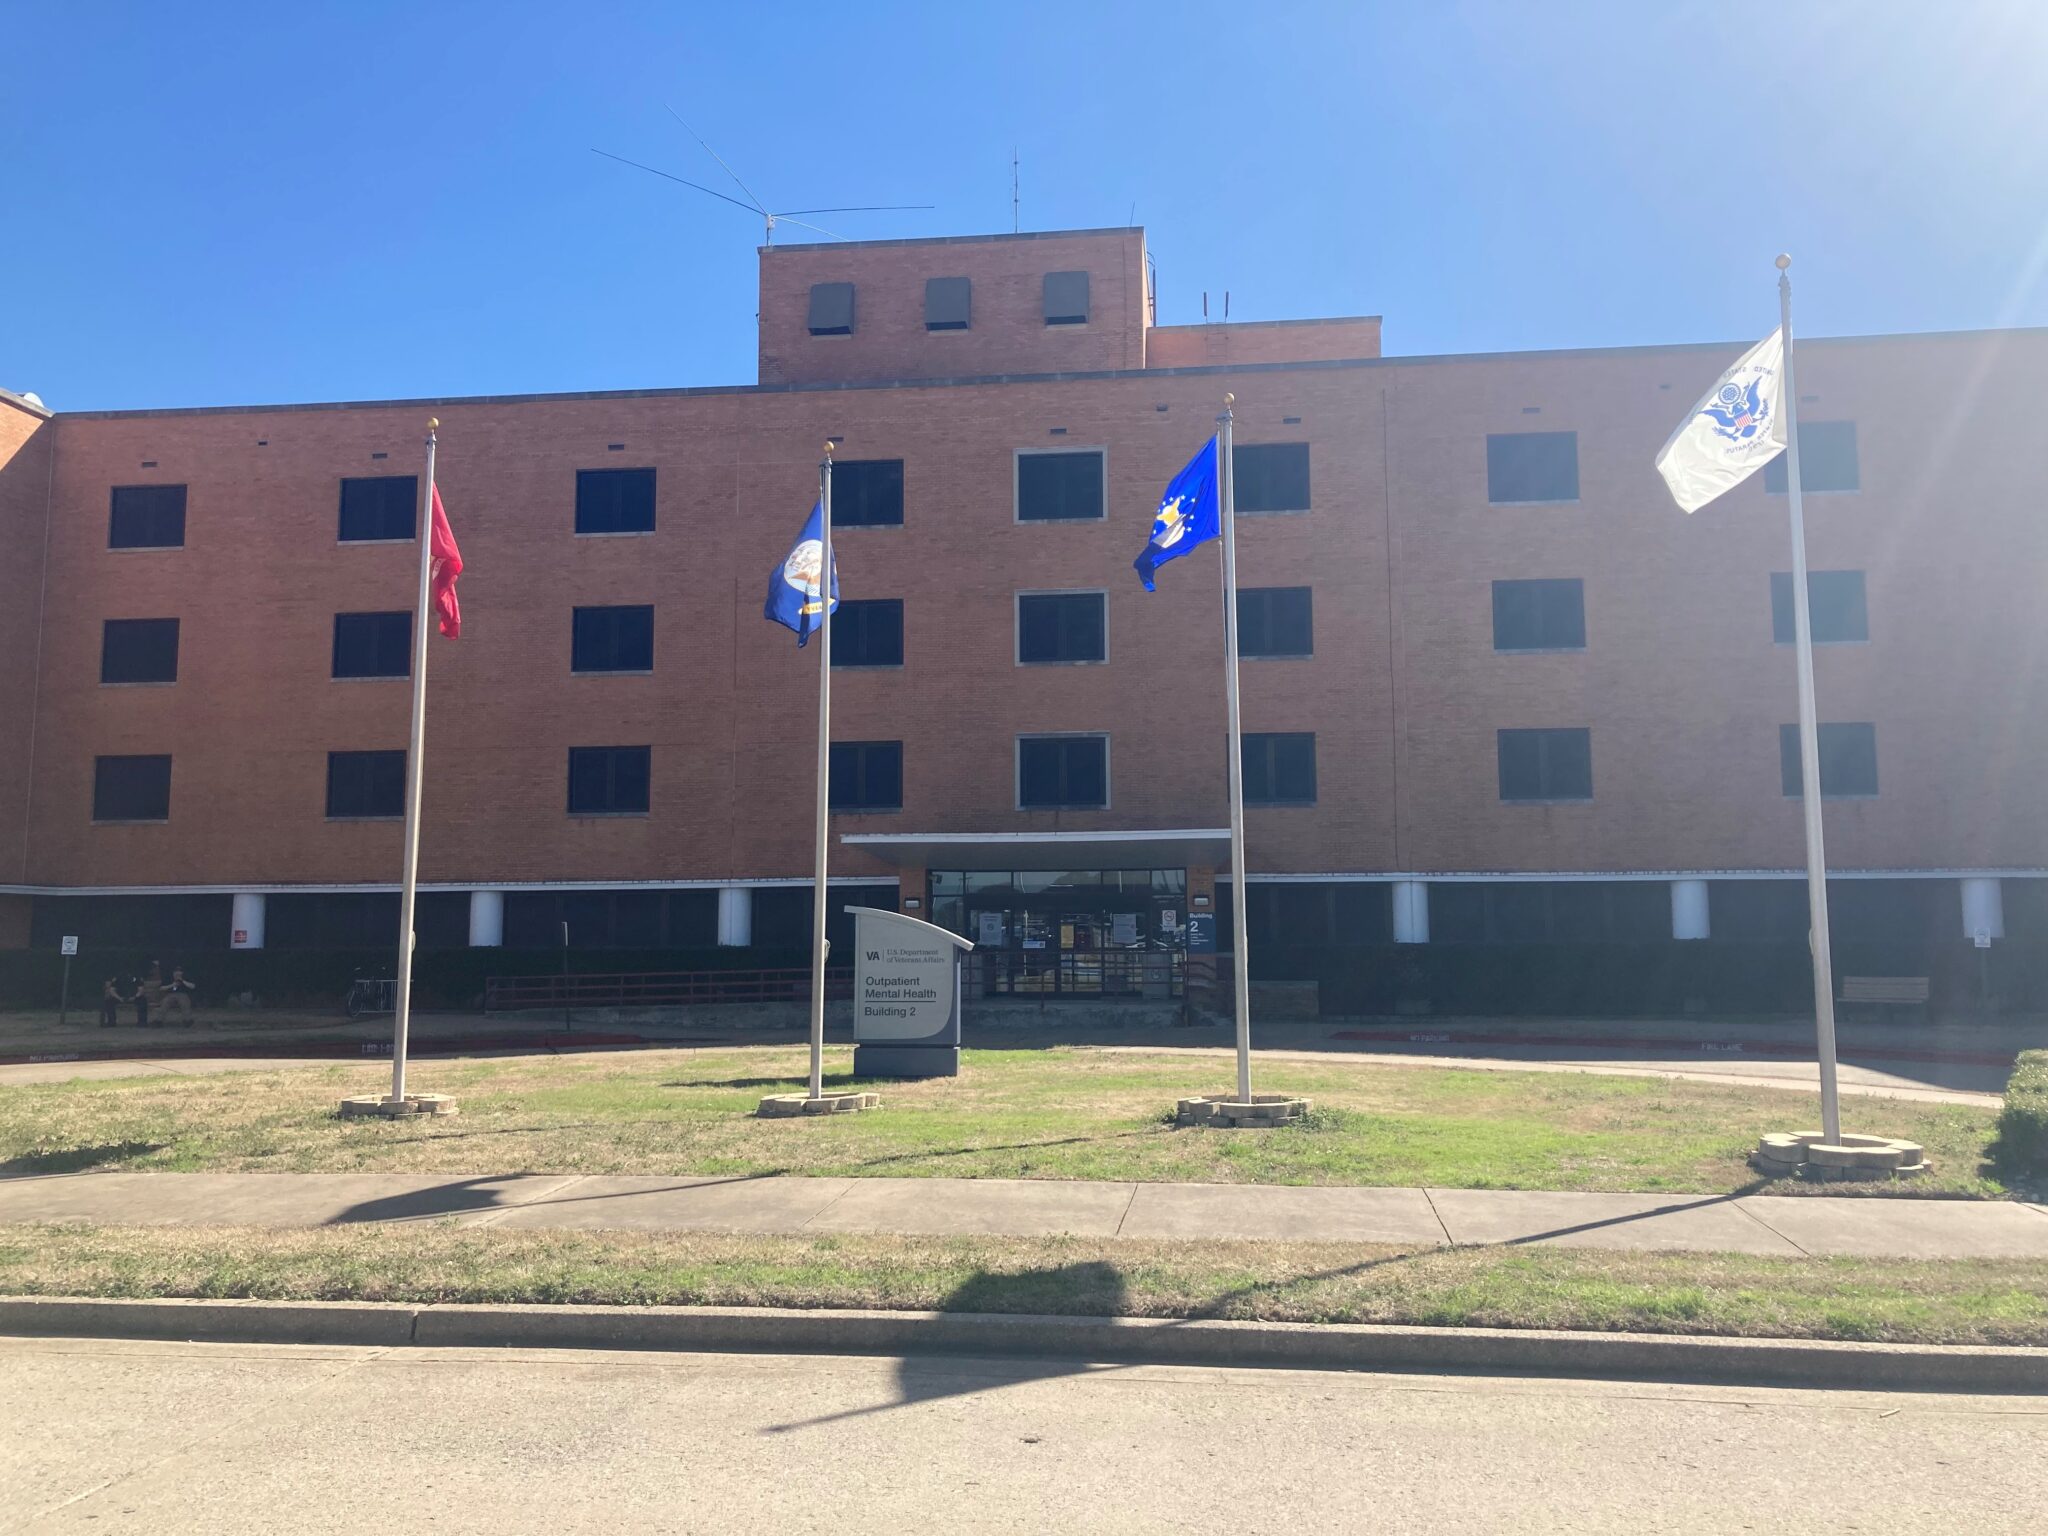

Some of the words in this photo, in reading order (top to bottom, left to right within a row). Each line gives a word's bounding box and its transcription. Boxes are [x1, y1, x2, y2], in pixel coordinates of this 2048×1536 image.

[1189, 912, 1213, 920] Building
[1190, 920, 1199, 932] 2
[866, 951, 880, 961] VA
[900, 949, 939, 957] Department
[865, 976, 920, 987] Outpatient
[865, 989, 900, 998] Mental
[904, 989, 937, 998] Health
[864, 1007, 907, 1018] Building
[910, 1007, 916, 1016] 2
